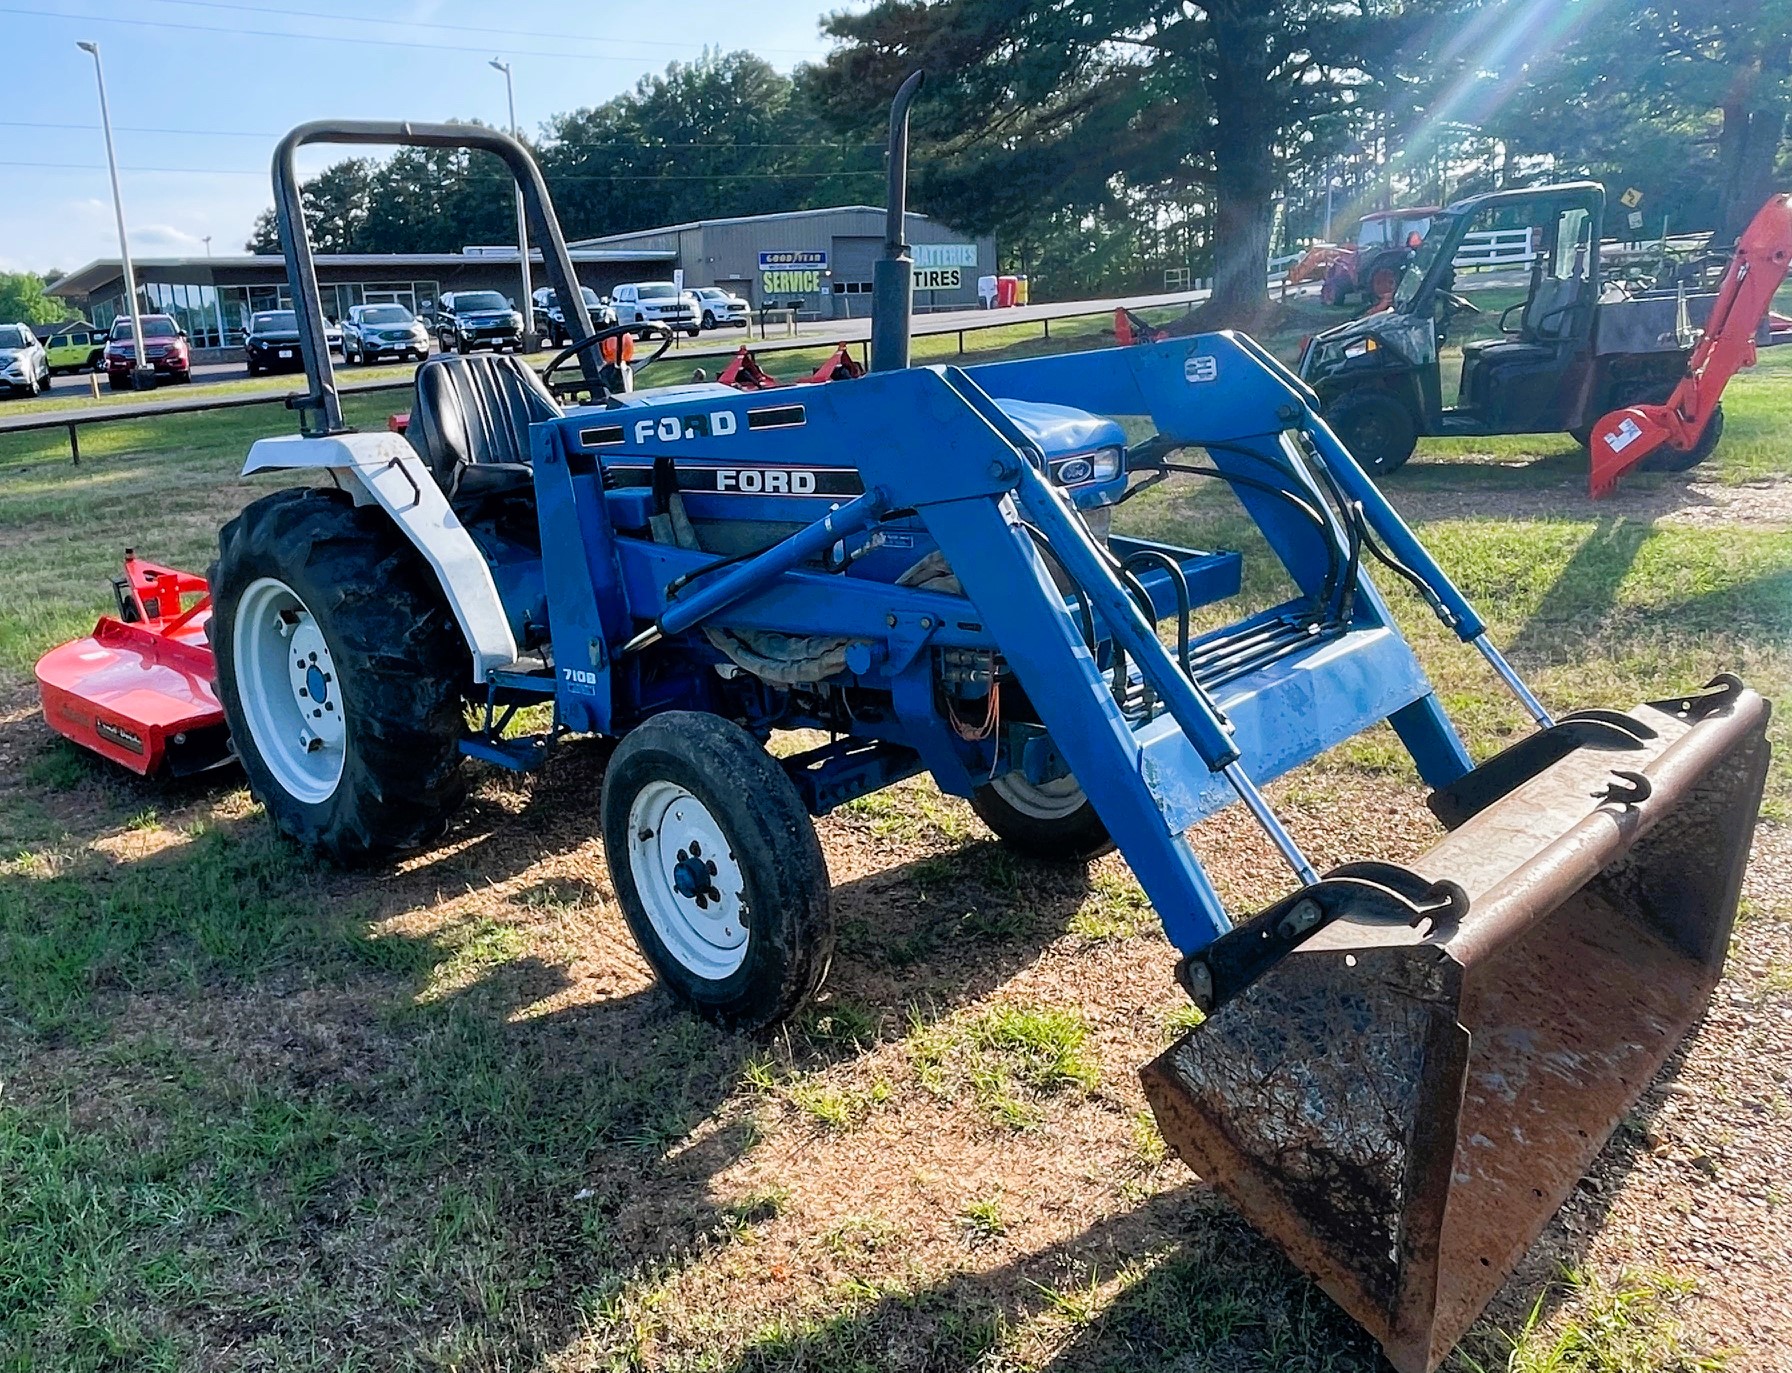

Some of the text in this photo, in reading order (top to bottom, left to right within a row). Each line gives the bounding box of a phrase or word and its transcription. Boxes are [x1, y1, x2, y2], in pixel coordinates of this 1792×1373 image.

[766, 252, 821, 263] GOODYEAR
[763, 270, 820, 294] SERVICE
[913, 270, 960, 287] TIRES
[634, 410, 737, 444] FORD
[716, 470, 816, 494] FORD
